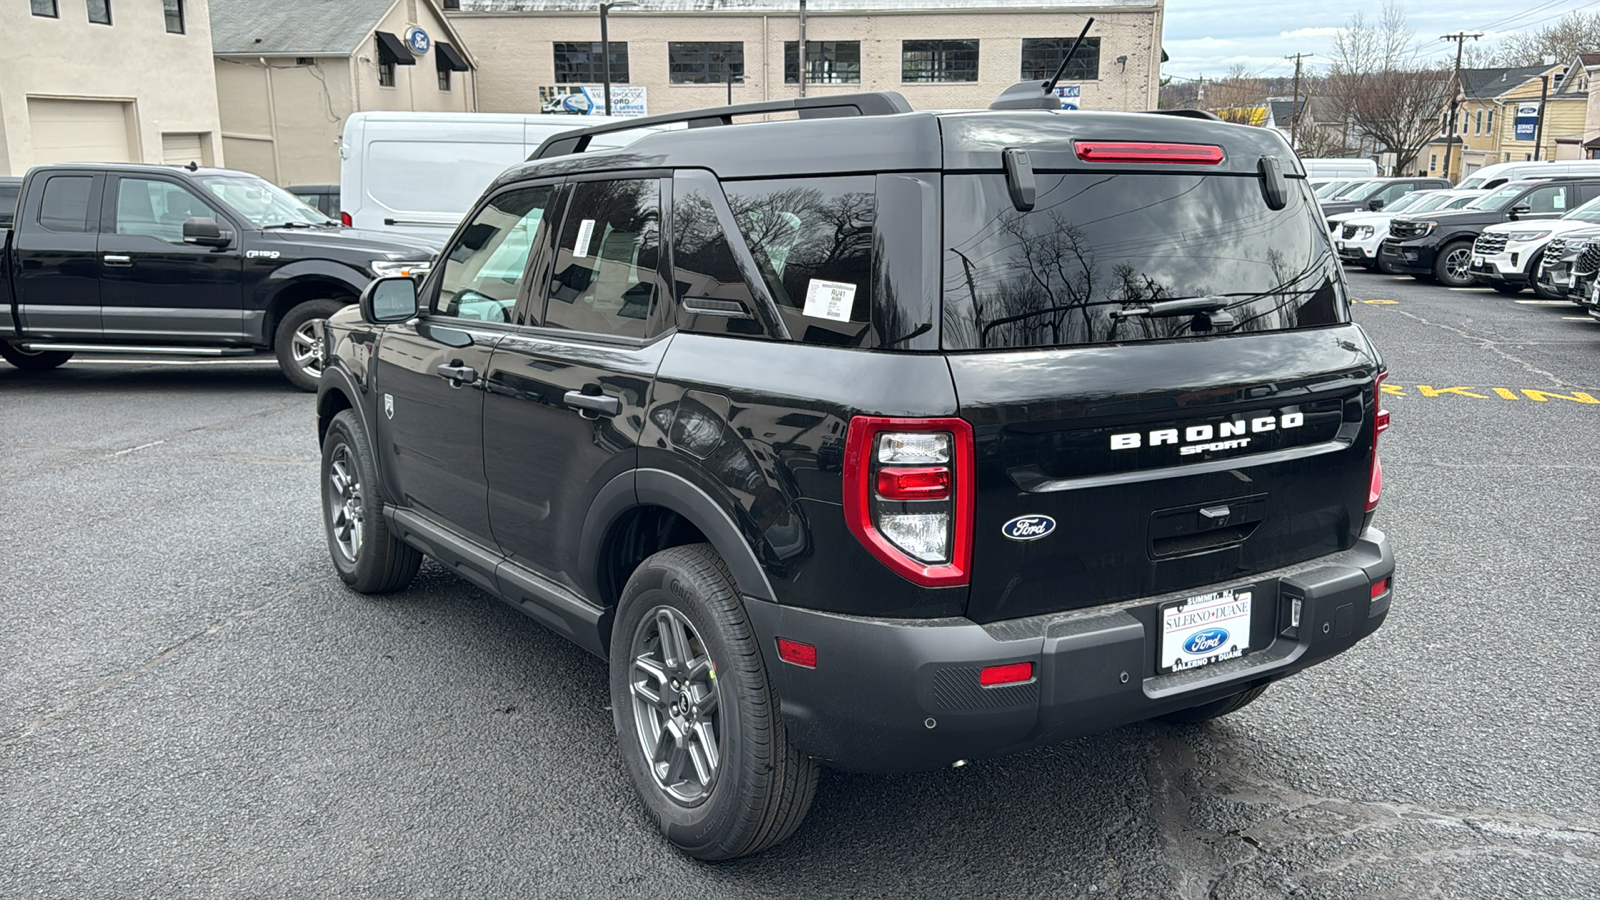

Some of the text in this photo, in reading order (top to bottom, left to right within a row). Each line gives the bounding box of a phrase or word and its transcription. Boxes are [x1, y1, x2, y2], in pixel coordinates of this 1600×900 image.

[414, 32, 428, 49] Ford
[1110, 412, 1304, 451] BRONCO
[1180, 437, 1251, 456] SPORT
[1012, 518, 1047, 537] Ford
[1223, 589, 1234, 599] NJ
[1165, 601, 1249, 630] SALERNO DUANE
[1191, 631, 1221, 652] Ford
[1172, 649, 1243, 673] SALERNO DUANE
